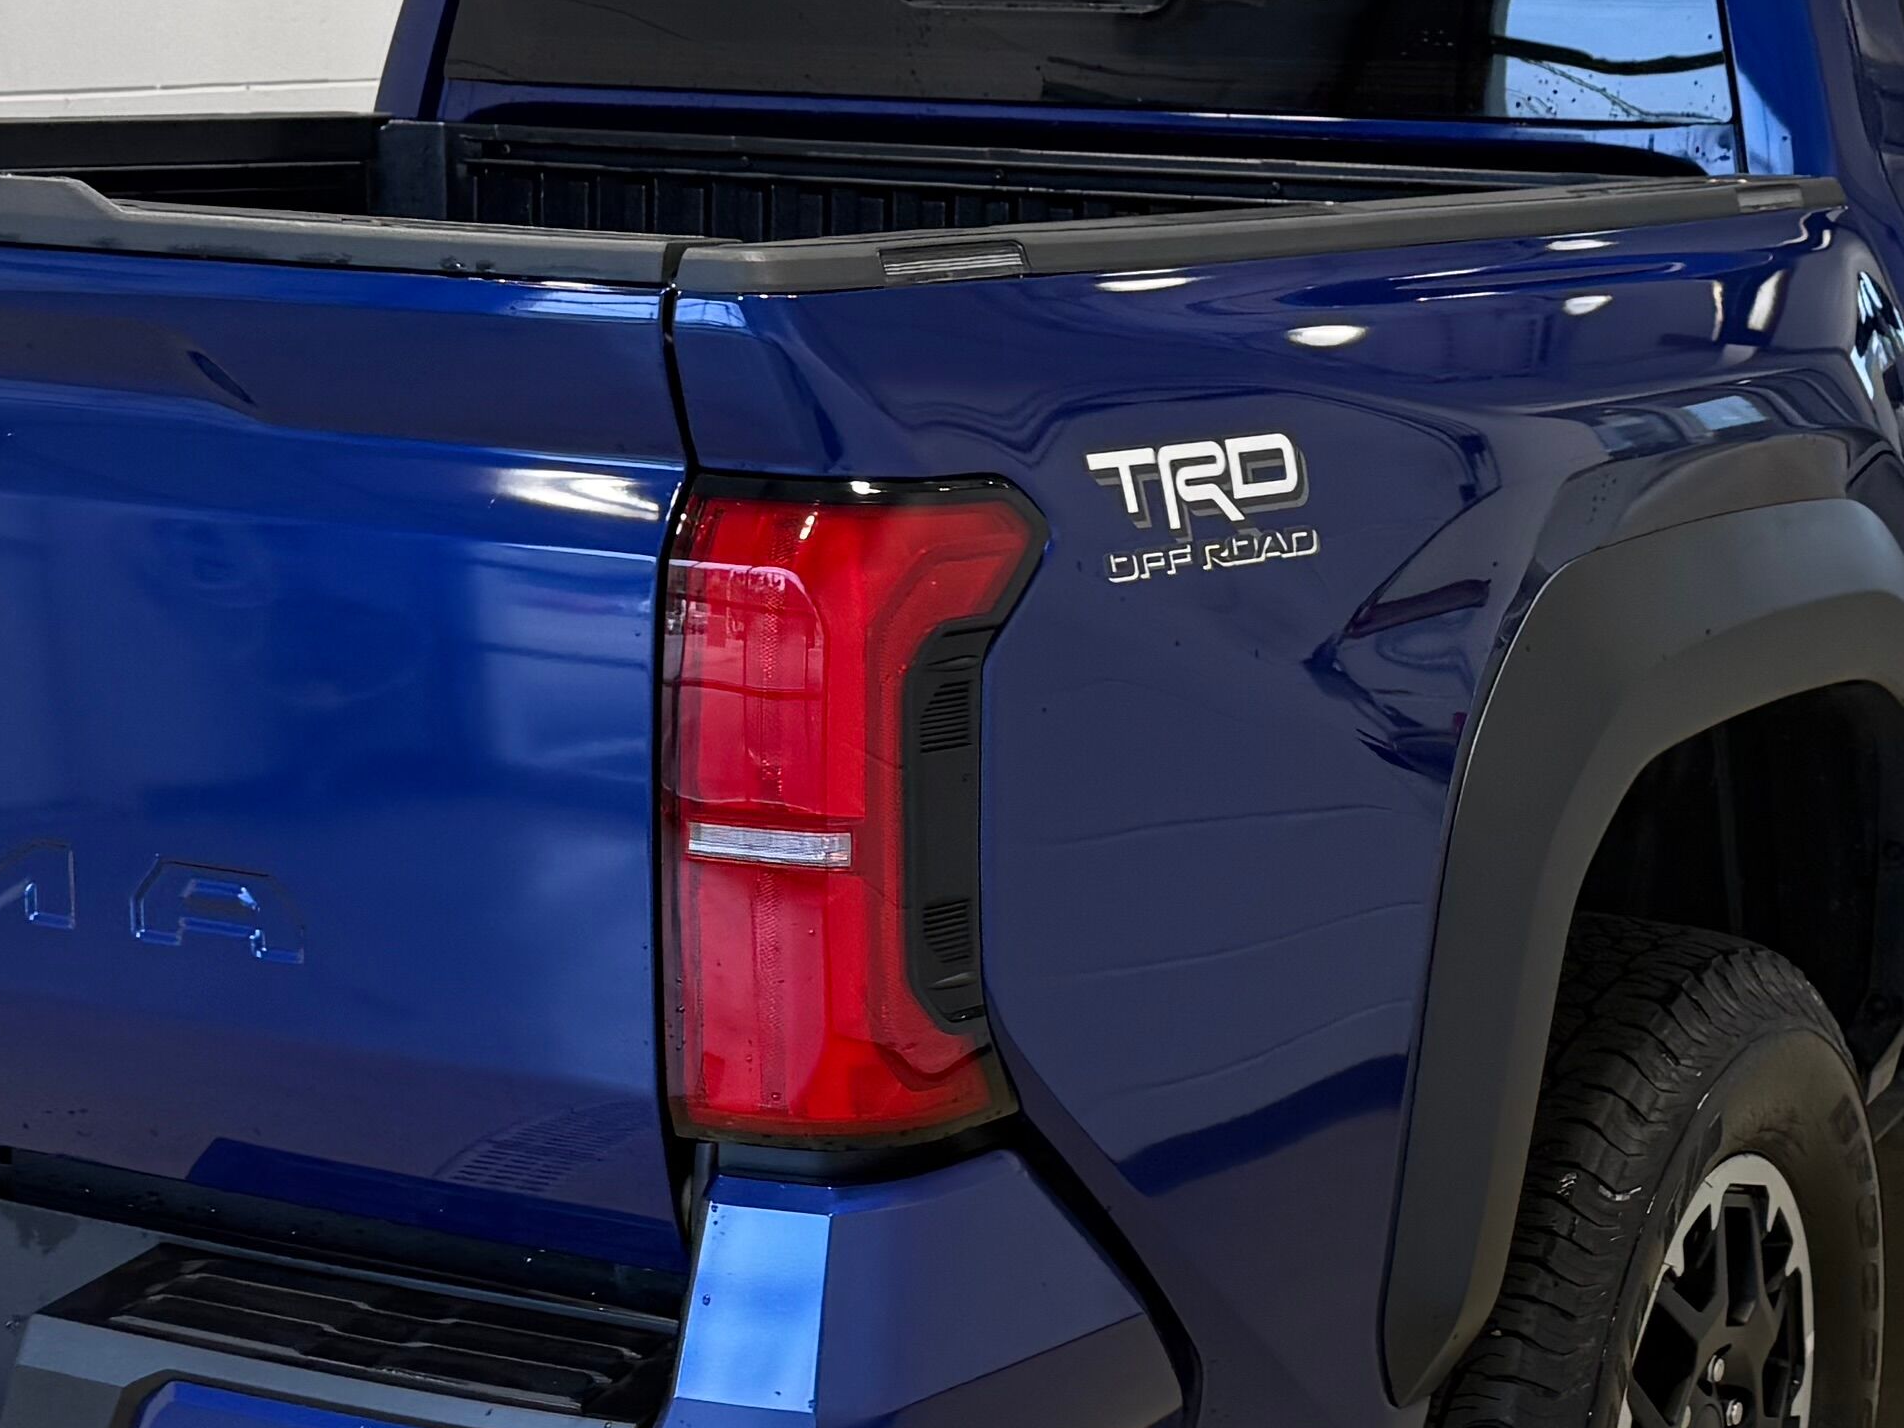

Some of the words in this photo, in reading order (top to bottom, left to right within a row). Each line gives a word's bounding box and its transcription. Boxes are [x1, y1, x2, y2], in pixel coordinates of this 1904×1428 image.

[1085, 433, 1302, 532] TRD
[1106, 542, 1193, 584] OFF
[1202, 527, 1321, 571] ROAD
